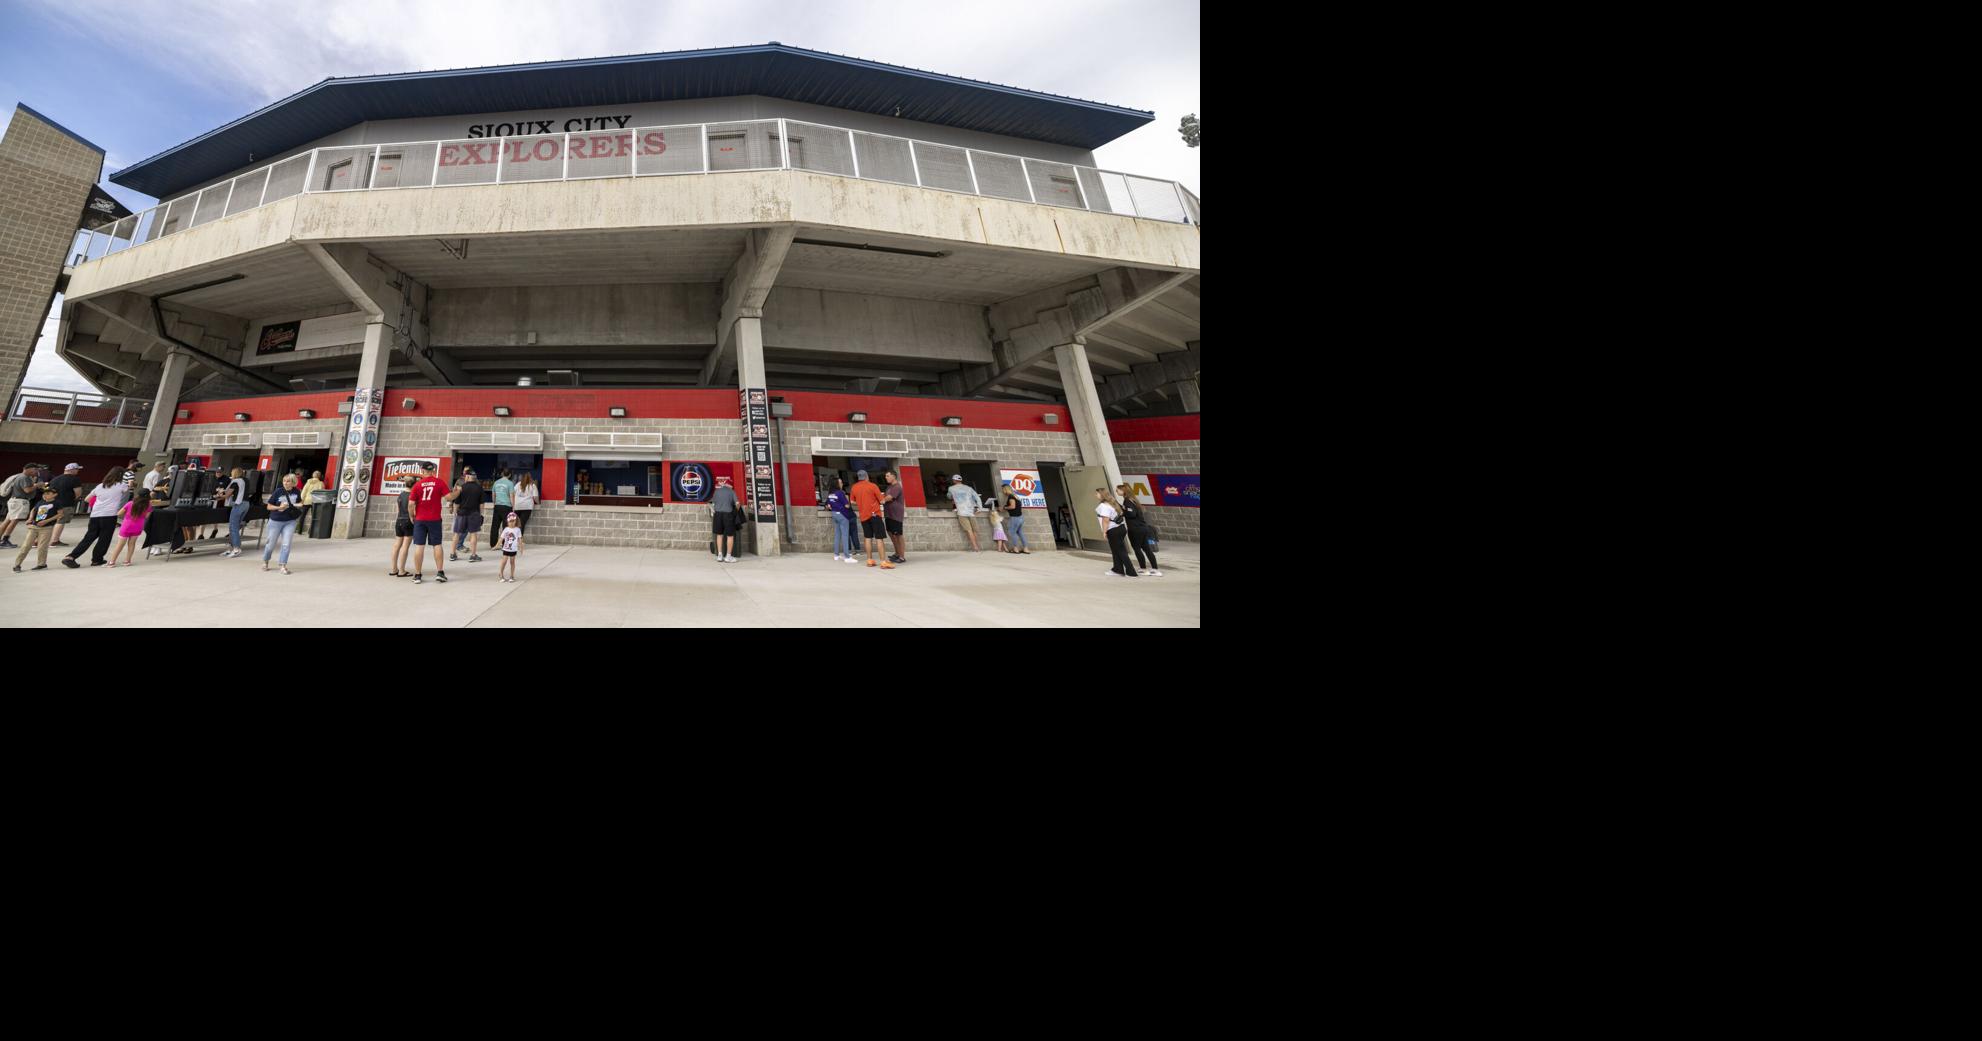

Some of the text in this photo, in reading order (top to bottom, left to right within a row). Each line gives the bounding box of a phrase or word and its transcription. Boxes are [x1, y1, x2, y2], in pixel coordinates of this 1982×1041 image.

[467, 115, 632, 139] SIOUX CITY
[439, 132, 666, 166] EXPLORERS
[421, 487, 434, 501] 17
[1014, 478, 1033, 492] DQ
